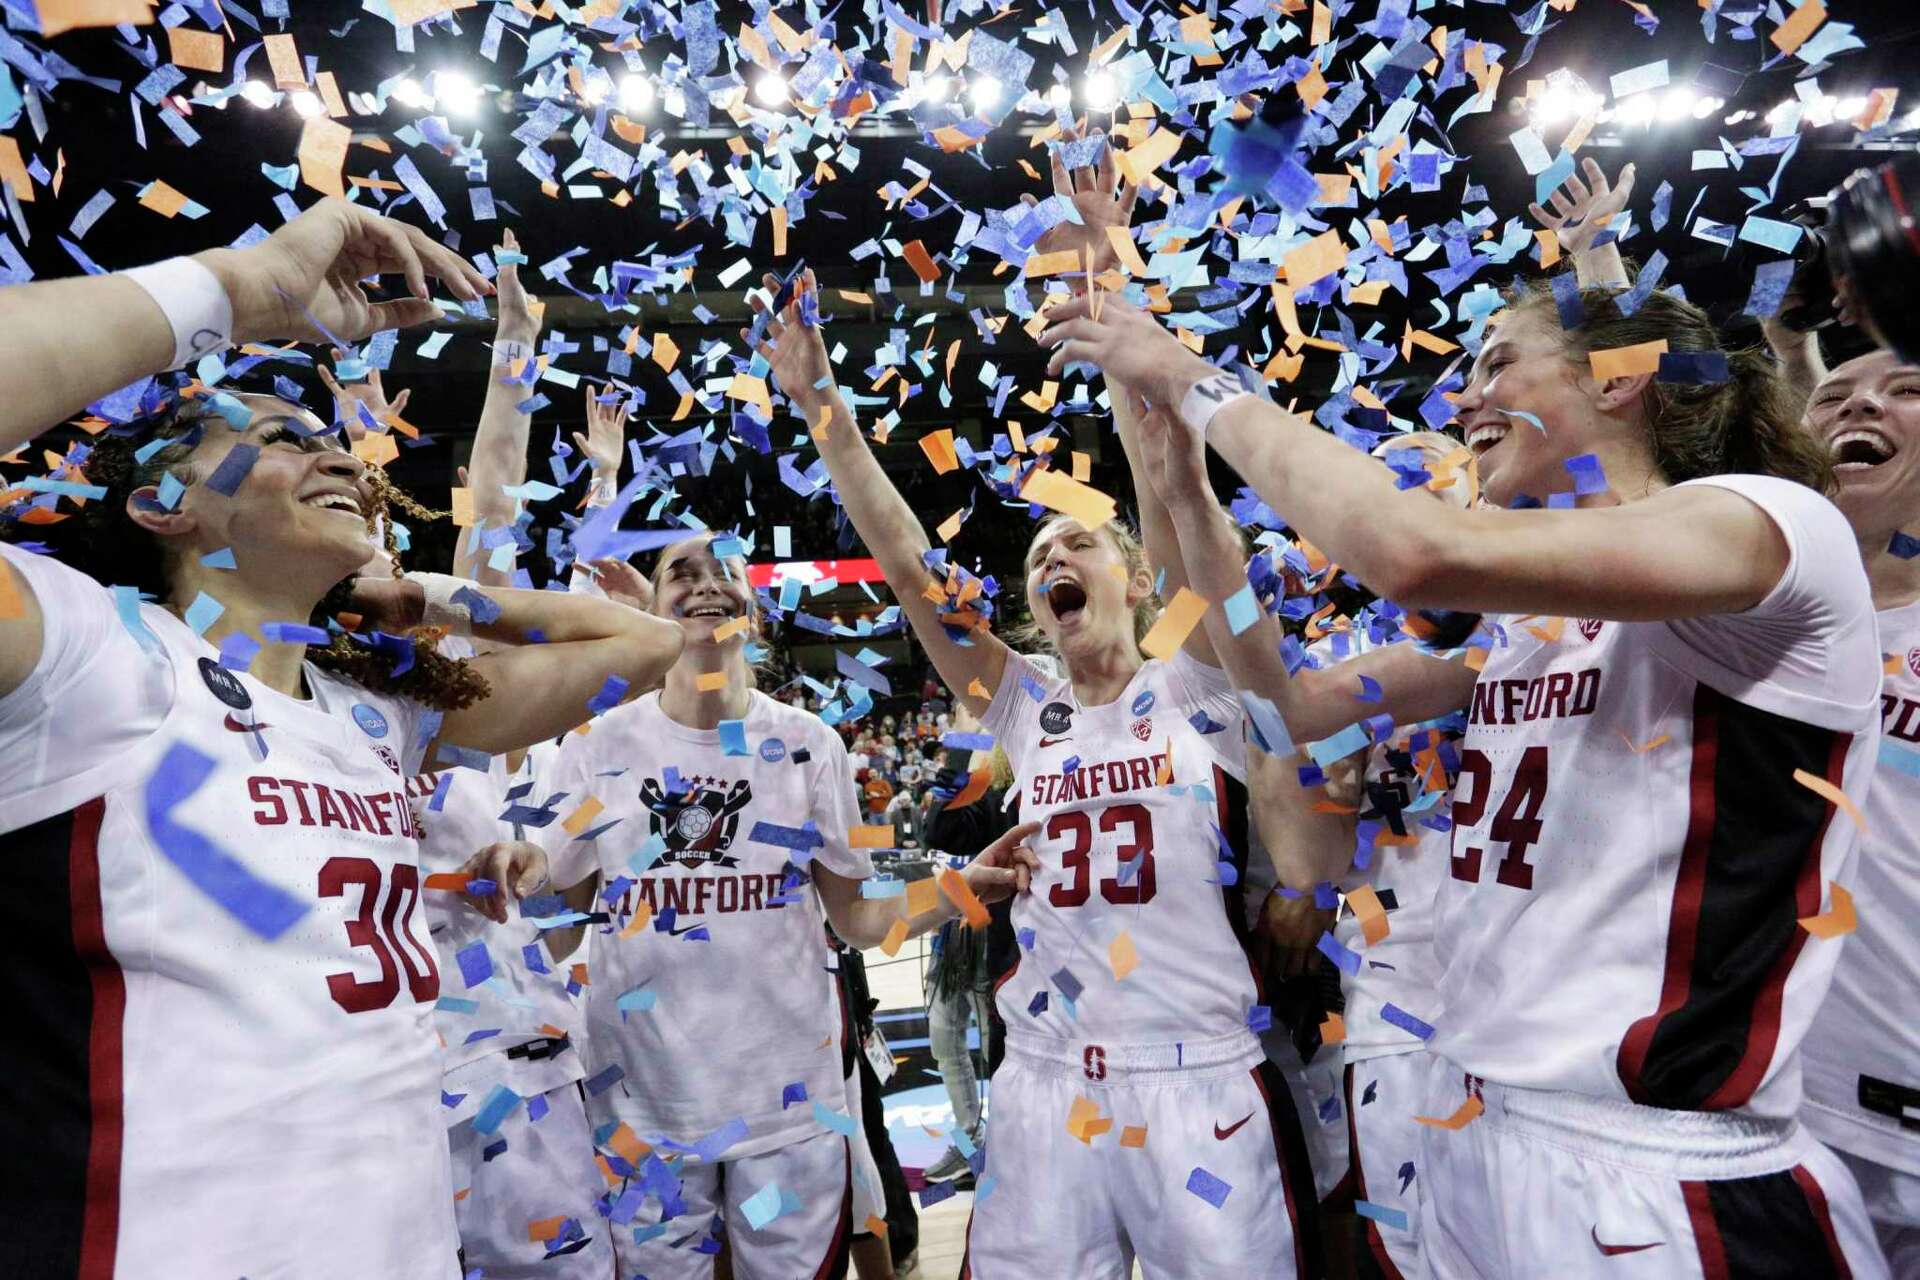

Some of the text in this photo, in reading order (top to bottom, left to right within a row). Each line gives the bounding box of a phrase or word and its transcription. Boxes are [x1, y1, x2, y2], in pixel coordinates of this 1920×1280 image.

[247, 776, 414, 839] STANFO
[1032, 753, 1175, 806] STANFORD
[1451, 746, 1548, 890] 24
[675, 850, 711, 860] SOCCER
[1047, 803, 1157, 908] 33
[318, 856, 441, 1014] 30
